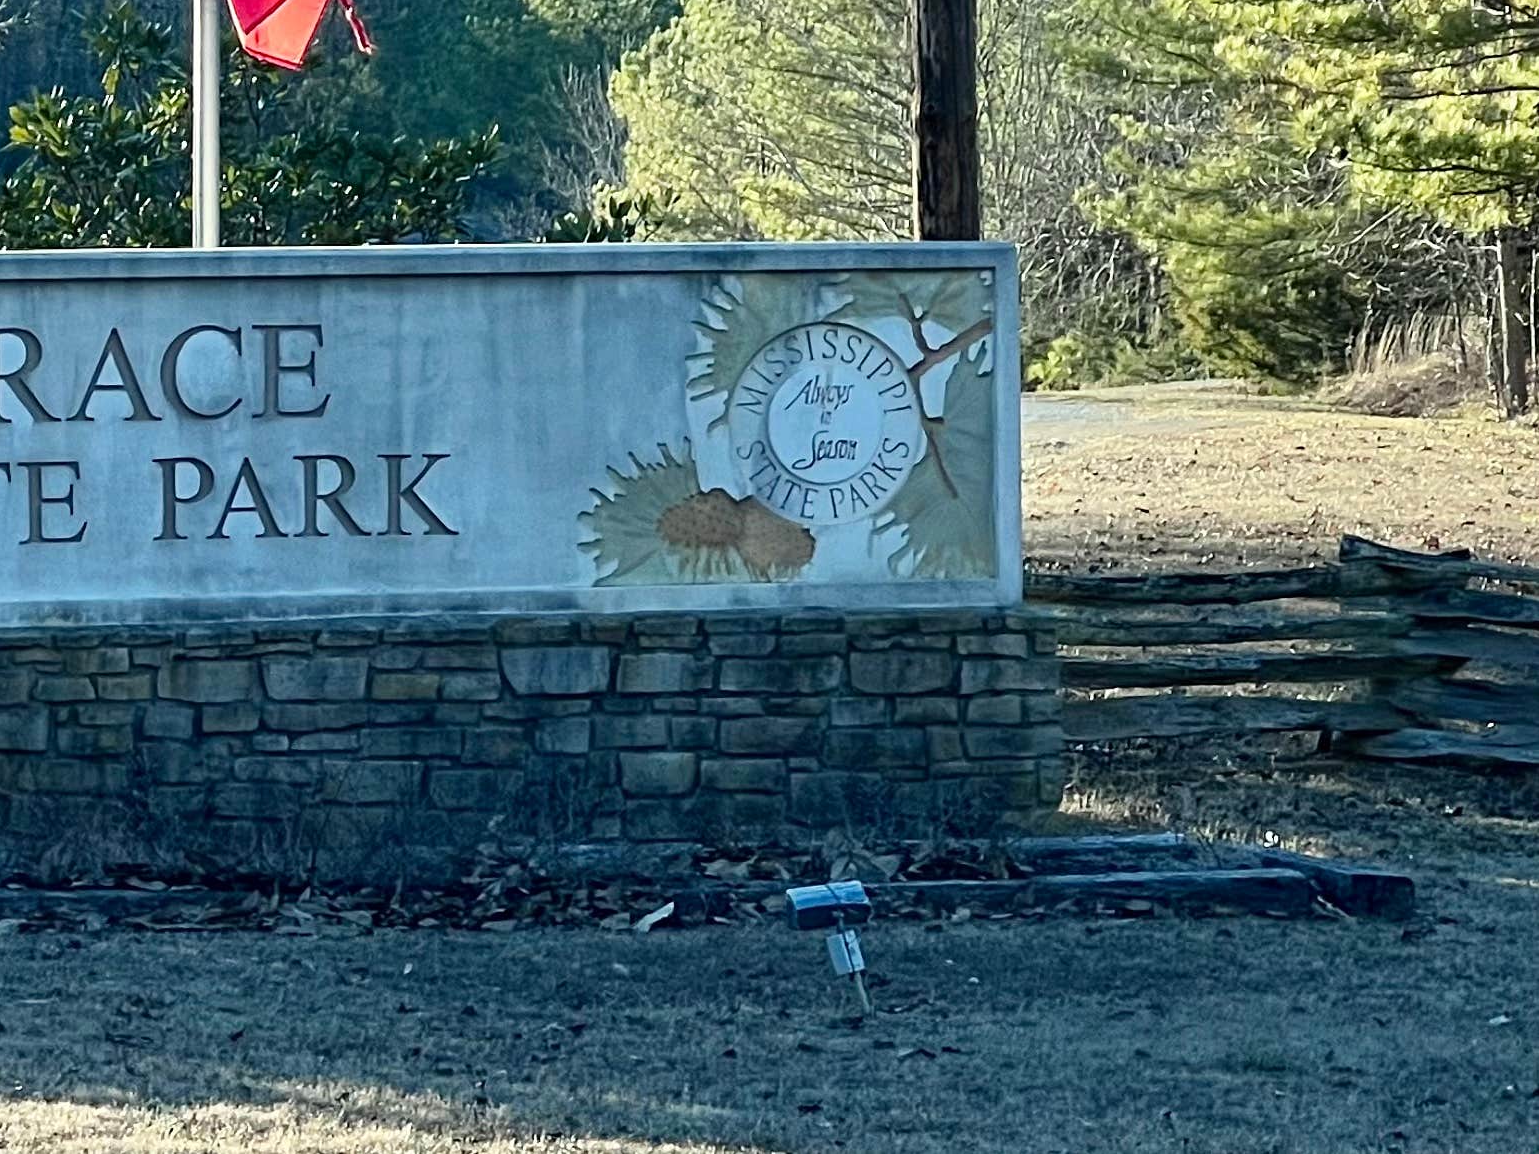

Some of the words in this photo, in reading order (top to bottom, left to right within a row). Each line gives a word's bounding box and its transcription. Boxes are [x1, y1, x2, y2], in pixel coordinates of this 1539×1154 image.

[735, 327, 911, 414] MISSISSIPPI
[784, 374, 855, 410] Always
[736, 439, 816, 520] STATE
[829, 437, 911, 520] PARKS
[791, 430, 858, 470] Season
[152, 453, 460, 541] PARK
